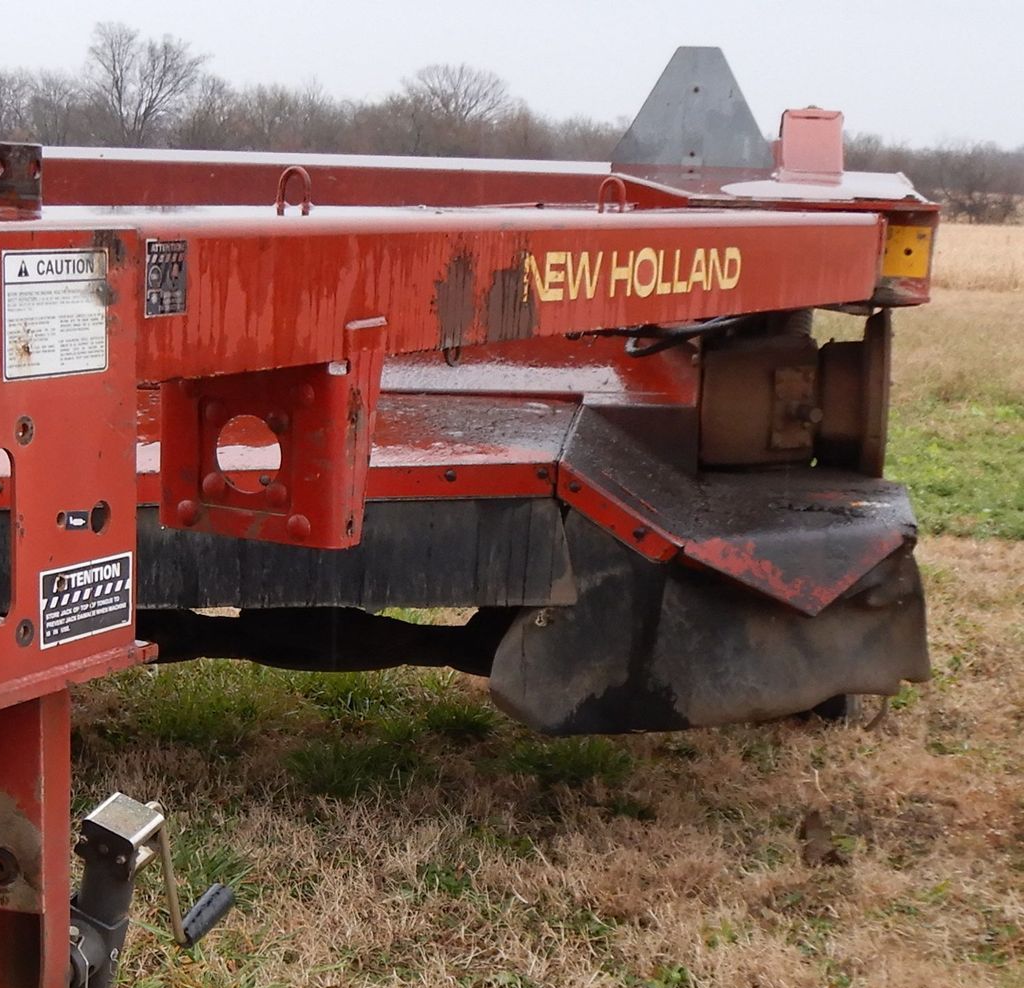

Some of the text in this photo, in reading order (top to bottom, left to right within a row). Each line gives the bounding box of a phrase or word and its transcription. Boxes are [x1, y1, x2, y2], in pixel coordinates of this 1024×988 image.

[36, 258, 95, 276] CAUTION
[523, 247, 741, 302] NEW HOLLAND
